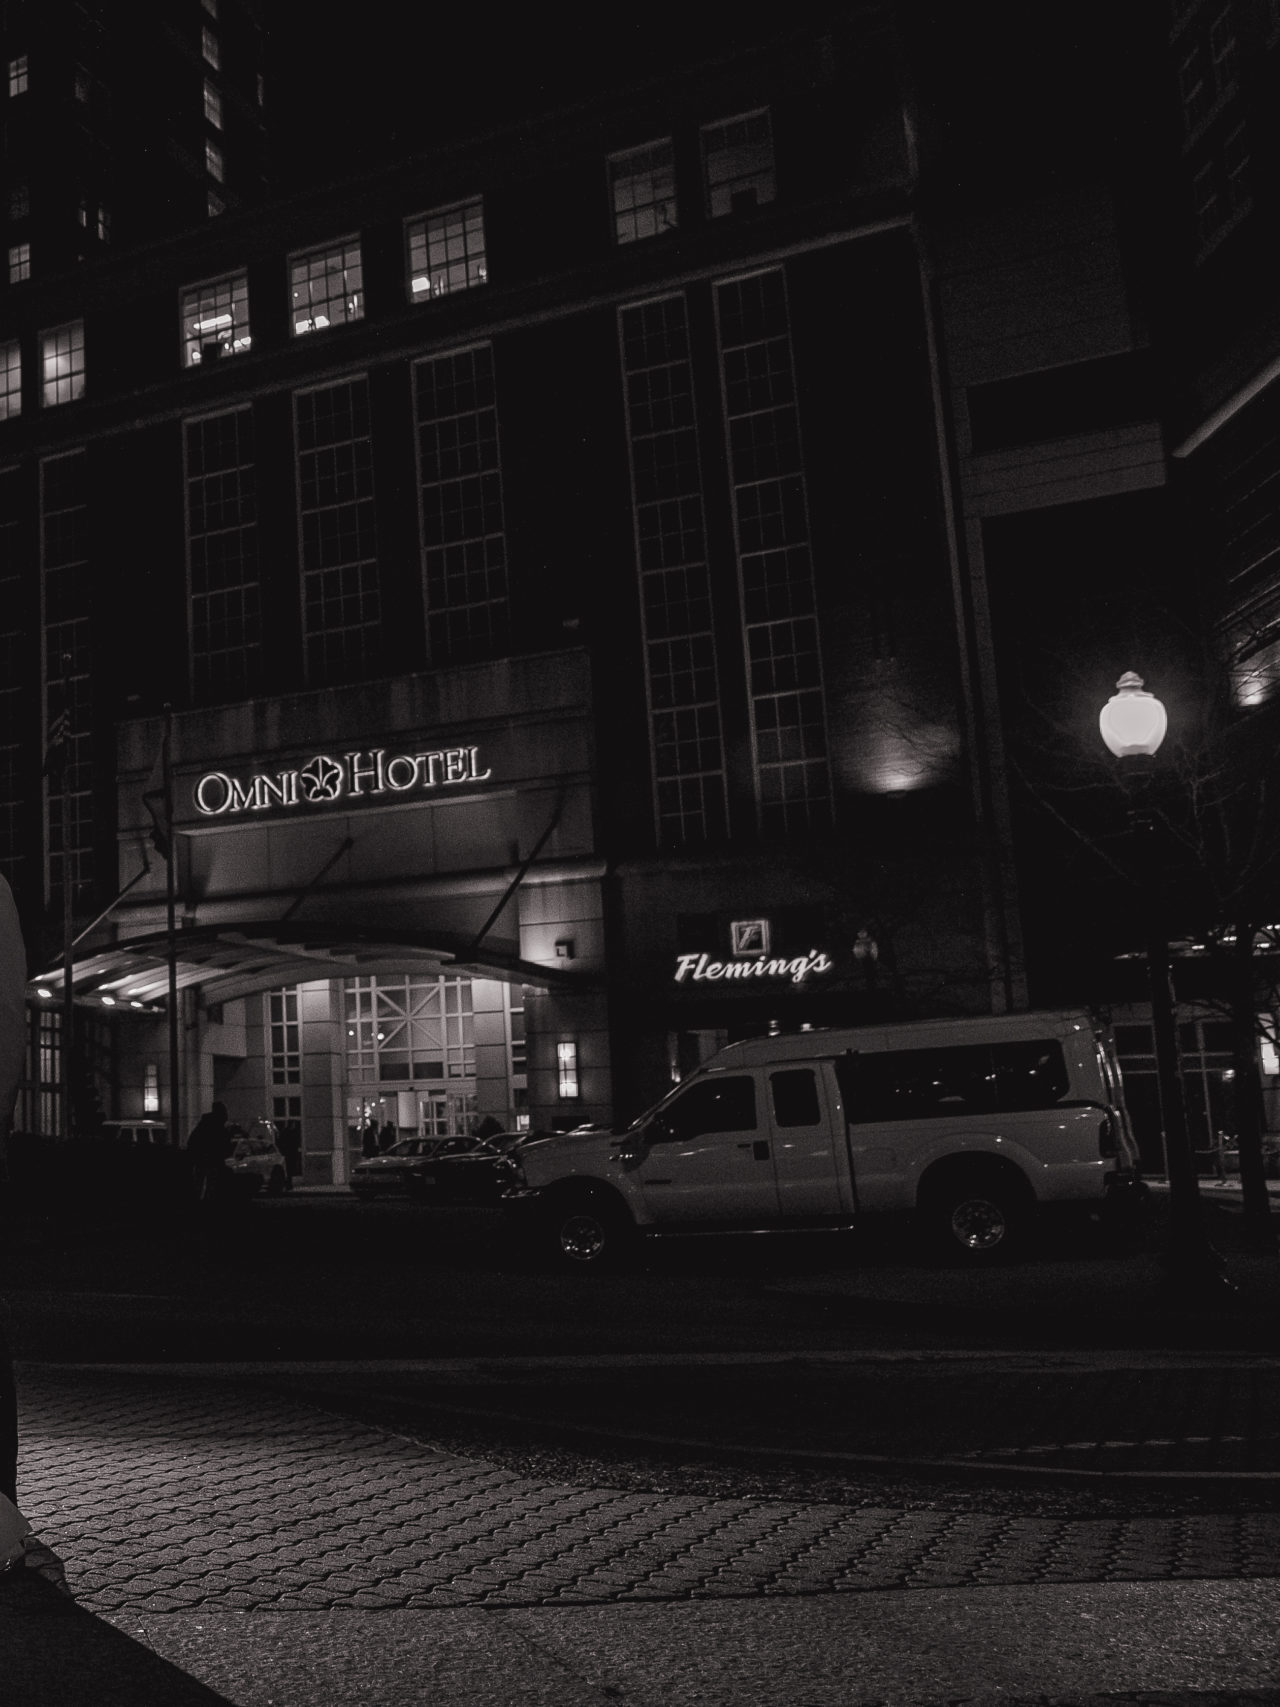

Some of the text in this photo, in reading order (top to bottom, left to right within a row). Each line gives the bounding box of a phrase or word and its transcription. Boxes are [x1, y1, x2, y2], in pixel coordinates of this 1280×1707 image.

[196, 747, 491, 815] OMNI HOTEL
[674, 949, 832, 983] Fleming's
